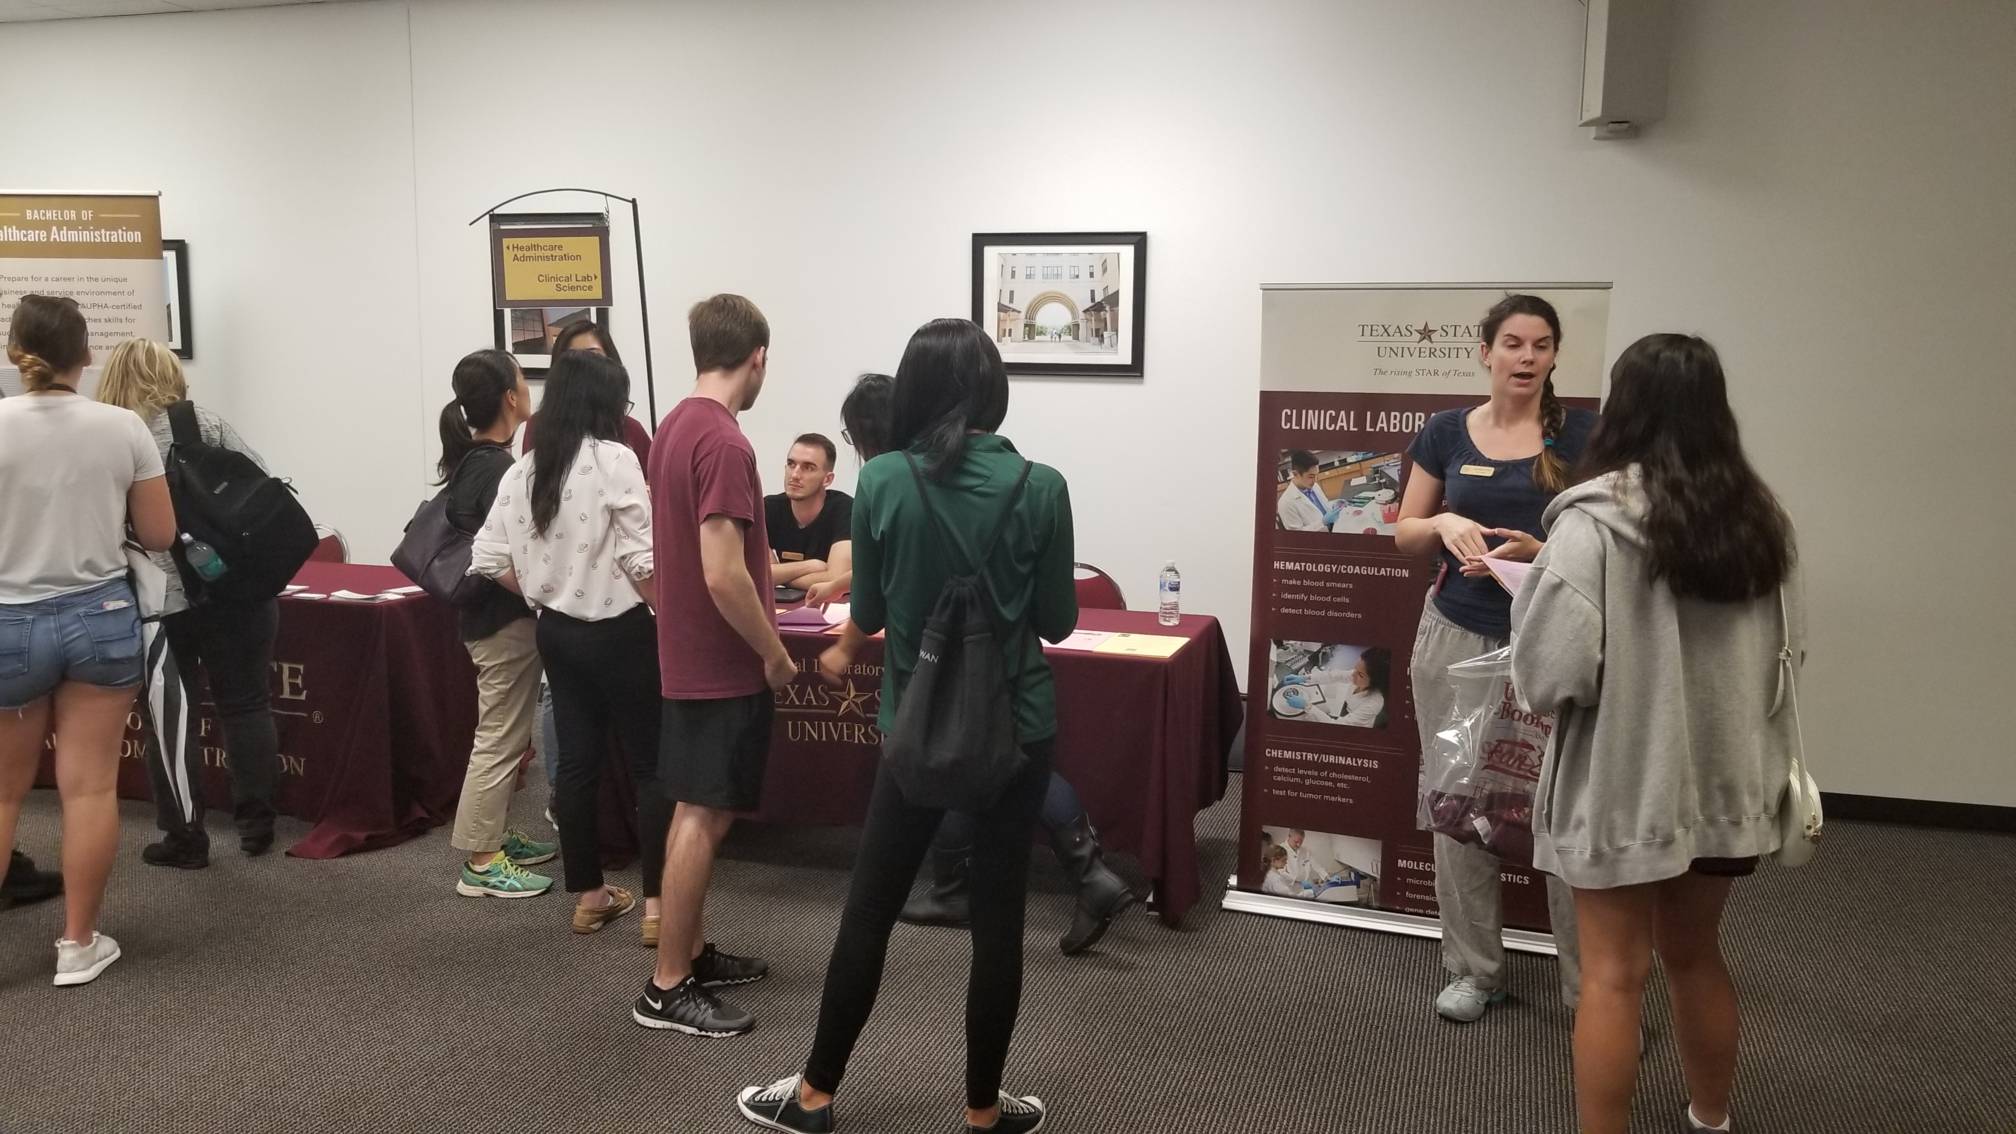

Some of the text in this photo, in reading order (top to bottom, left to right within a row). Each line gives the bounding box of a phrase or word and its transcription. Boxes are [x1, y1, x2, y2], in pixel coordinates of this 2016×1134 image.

[26, 209, 94, 221] BACHELOR OF
[50, 226, 142, 243] Administration
[512, 243, 563, 252] Healthcare
[512, 252, 582, 263] Administration
[31, 274, 42, 282] for
[86, 275, 99, 283] the
[101, 276, 128, 285] unique
[537, 273, 593, 283] Clinical Lab
[46, 289, 74, 297] service
[76, 289, 125, 297] environment
[127, 289, 135, 297] of
[555, 283, 593, 292] Science
[104, 316, 122, 324] skills
[1358, 324, 1482, 338] TEXAS STAT
[1377, 346, 1474, 359] UNIVERSITY
[1373, 368, 1475, 378] The rising STAR of Texas
[1281, 408, 1436, 433] CLINICAL LABOR
[1273, 560, 1409, 578] HEMATOLOGY/COAGULATION
[1281, 578, 1353, 589] make blood smears
[1280, 591, 1350, 603] identify blood cells
[1280, 606, 1361, 619] detect blood disorders
[774, 684, 829, 706] EXAS
[1265, 748, 1379, 769] CHEMISTRY/URINALYSIS
[1273, 765, 1371, 783] detect levels of cholesterol,
[1273, 774, 1351, 789] calcium, glucose, etc.
[1272, 788, 1354, 804] test for tumor markers
[1500, 872, 1530, 885] STICS
